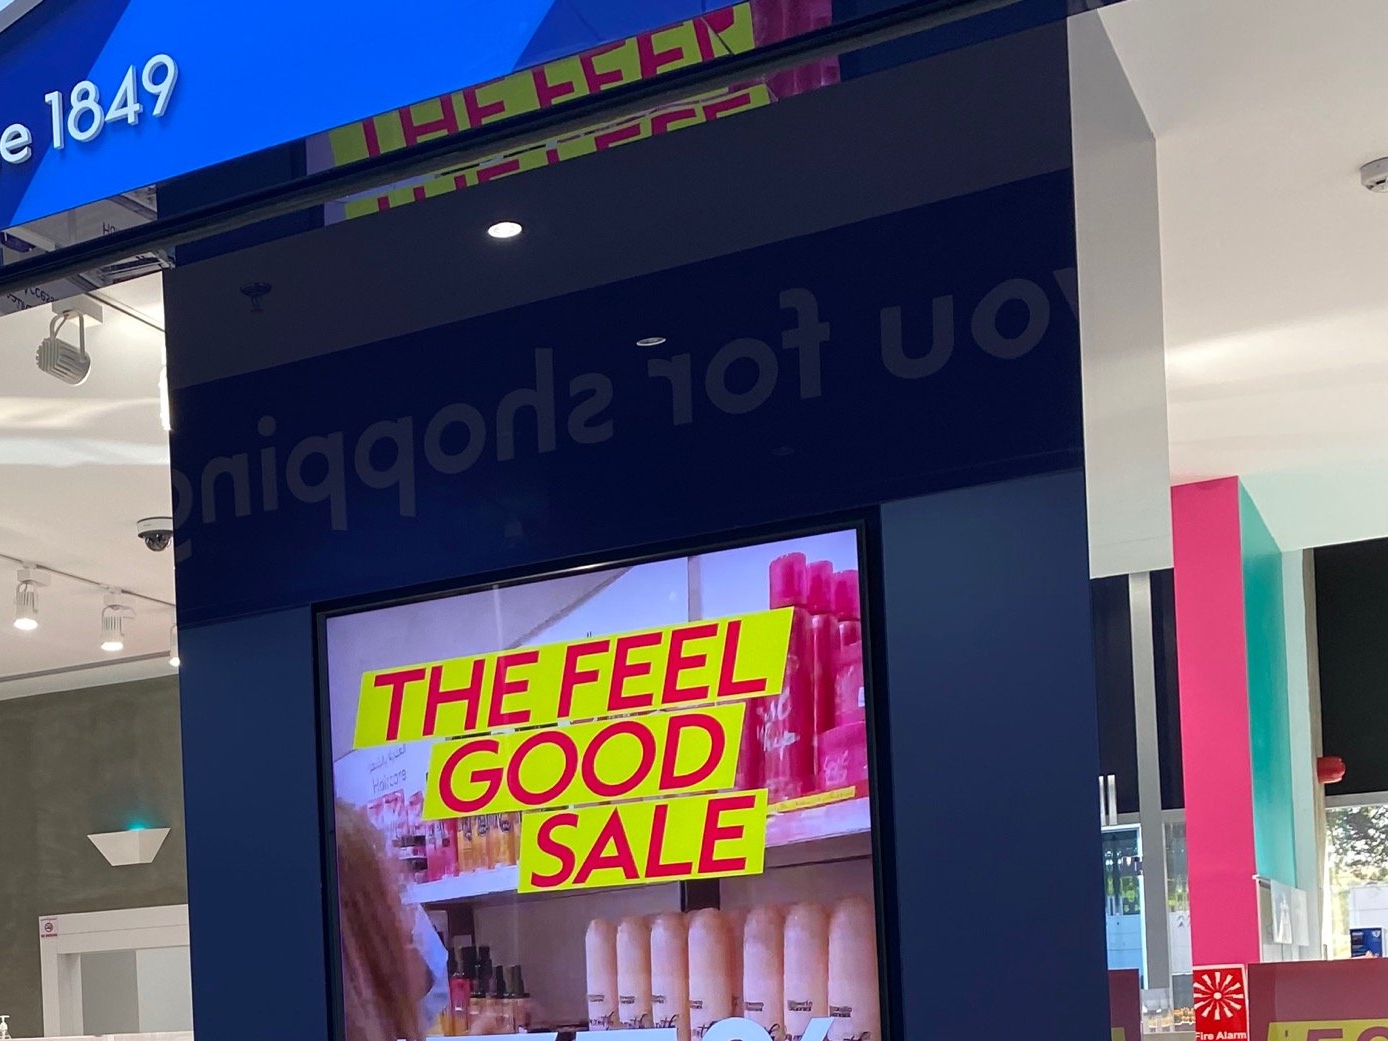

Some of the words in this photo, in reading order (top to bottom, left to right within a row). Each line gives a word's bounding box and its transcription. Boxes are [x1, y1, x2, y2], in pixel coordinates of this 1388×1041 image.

[44, 53, 180, 149] 1849
[373, 650, 540, 741] THE
[556, 620, 767, 719] FEEL
[438, 713, 726, 813] GOOD
[530, 794, 756, 888] SALE
[1216, 1030, 1247, 1040] Alarm
